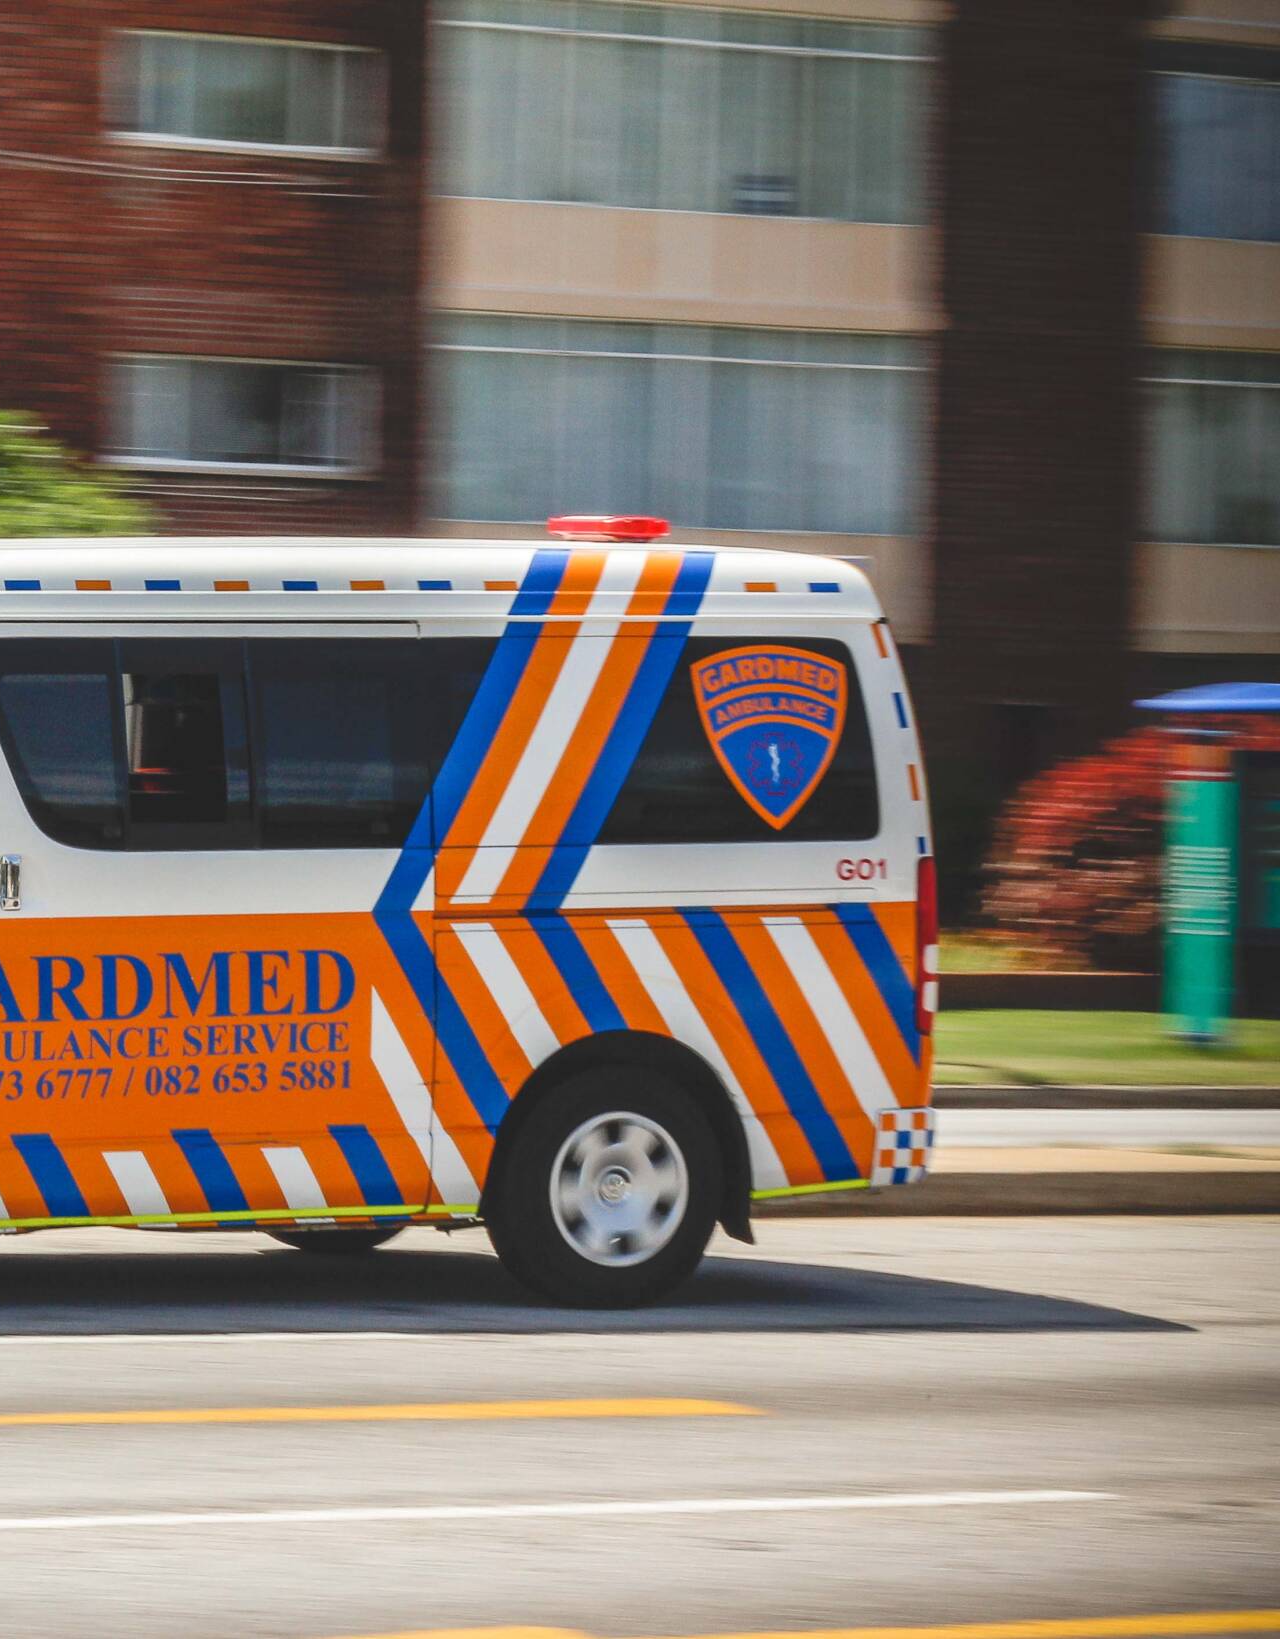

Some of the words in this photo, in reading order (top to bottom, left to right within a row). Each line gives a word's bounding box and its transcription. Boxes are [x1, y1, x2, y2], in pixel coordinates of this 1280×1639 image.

[702, 656, 837, 693] GARDMED
[716, 697, 828, 724] AMBULANCE
[182, 1021, 350, 1058] SERVICE
[36, 1067, 113, 1100] 6777
[145, 1064, 201, 1096] 082
[212, 1061, 267, 1094] 653
[279, 1059, 351, 1091] 5881
